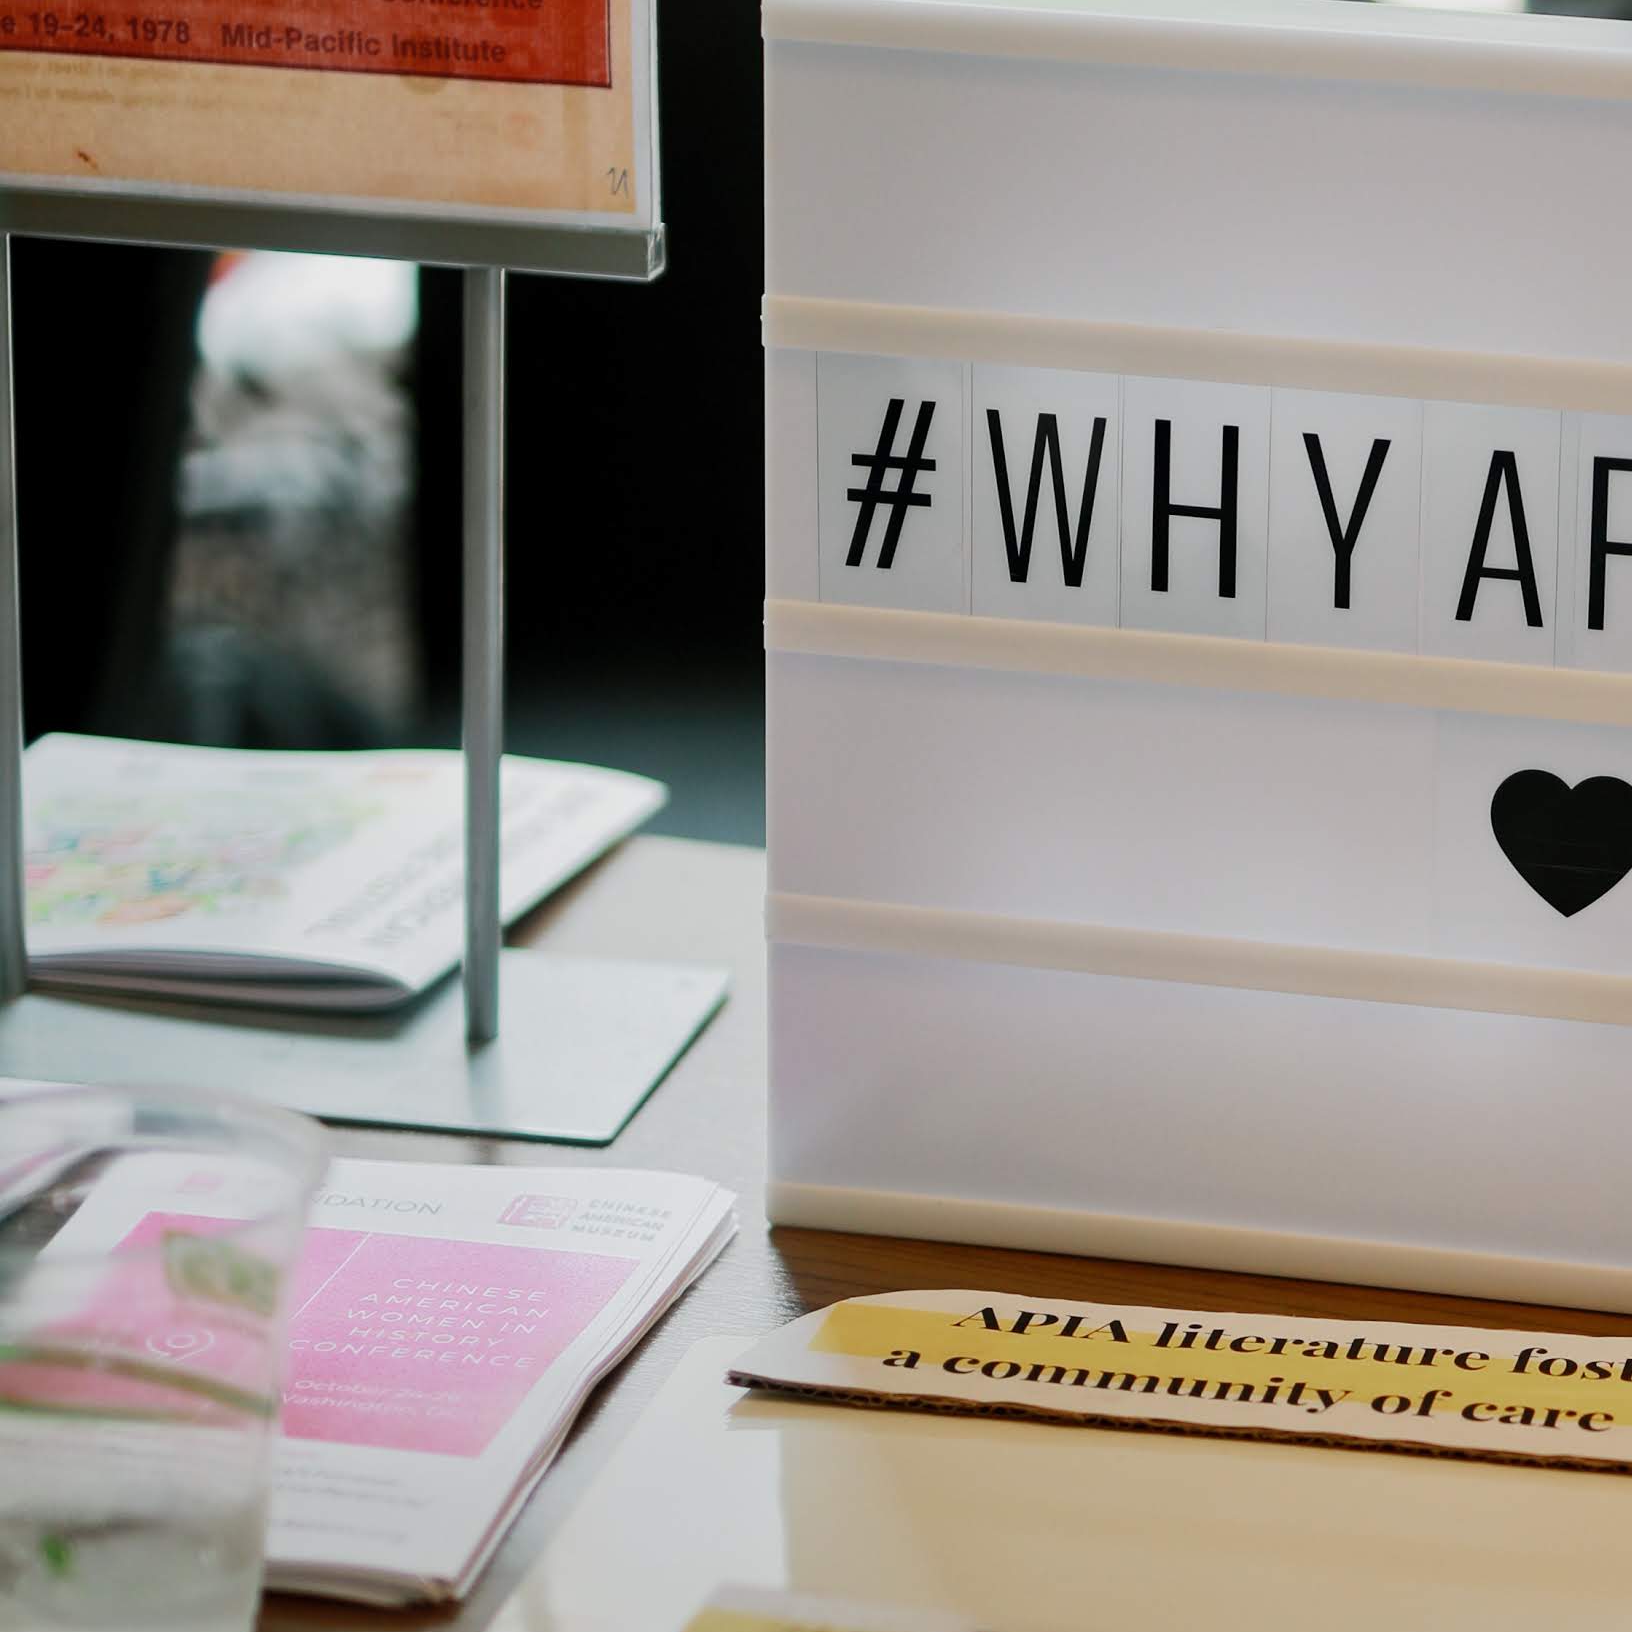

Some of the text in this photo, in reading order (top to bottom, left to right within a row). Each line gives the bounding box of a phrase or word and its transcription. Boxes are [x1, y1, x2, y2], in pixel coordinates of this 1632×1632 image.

[126, 16, 191, 45] 1978
[221, 23, 383, 58] Mid-Pacific
[391, 32, 508, 64] Institute
[392, 1277, 549, 1302] CHINESE
[359, 1292, 549, 1319] AMERICAN
[346, 1307, 538, 1335] WOMEN IN
[348, 1324, 505, 1347] HISTORY
[951, 1305, 1131, 1344] APIA
[1151, 1321, 1490, 1371] literature
[288, 1339, 538, 1368] CONFERENCE
[881, 1348, 922, 1370] a
[941, 1354, 1353, 1414] community
[1370, 1389, 1453, 1418] of
[1461, 1401, 1615, 1433] care
